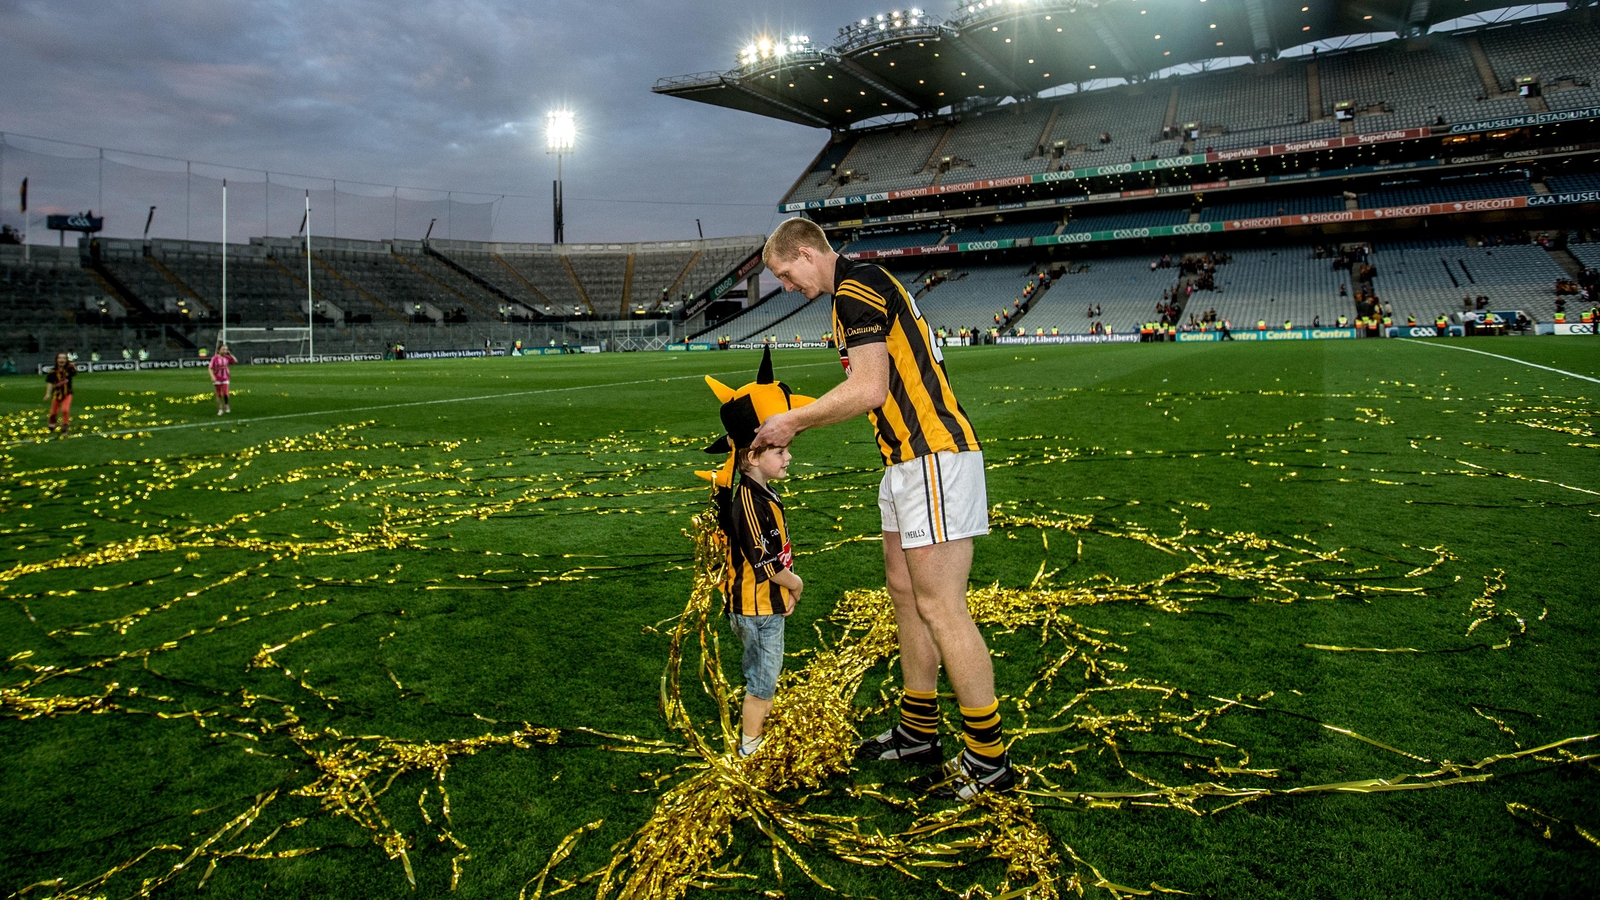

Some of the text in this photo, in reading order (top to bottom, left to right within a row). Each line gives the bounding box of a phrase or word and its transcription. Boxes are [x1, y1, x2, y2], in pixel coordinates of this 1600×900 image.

[1452, 123, 1475, 133] GAA
[1477, 117, 1524, 130] MUSEUM
[1526, 116, 1536, 124] &
[1539, 109, 1588, 122] STADIUM
[1358, 131, 1405, 143] SuperValu
[1285, 140, 1328, 152] SuperValu
[1218, 148, 1259, 160] SuperValu
[1527, 196, 1556, 206] GAA
[67, 216, 91, 227] GAA
[876, 248, 904, 257] SuperValu
[921, 244, 950, 254] SuperValu
[1475, 313, 1504, 324] GA
[1180, 332, 1214, 341] Centra
[1230, 331, 1258, 341] entra
[1265, 330, 1303, 340] Centra
[1312, 329, 1351, 339] Centra
[1409, 327, 1438, 337] GAA
[1001, 336, 1029, 345] Liberty
[1036, 335, 1063, 344] Liberty
[1071, 334, 1100, 344] Liberty
[1108, 333, 1139, 343] Liberty
[410, 351, 432, 359] Liberty
[436, 351, 457, 359] Liberty
[462, 350, 482, 358] Liberty
[92, 362, 134, 371] ETIHAD
[139, 361, 178, 369] ETIHAD
